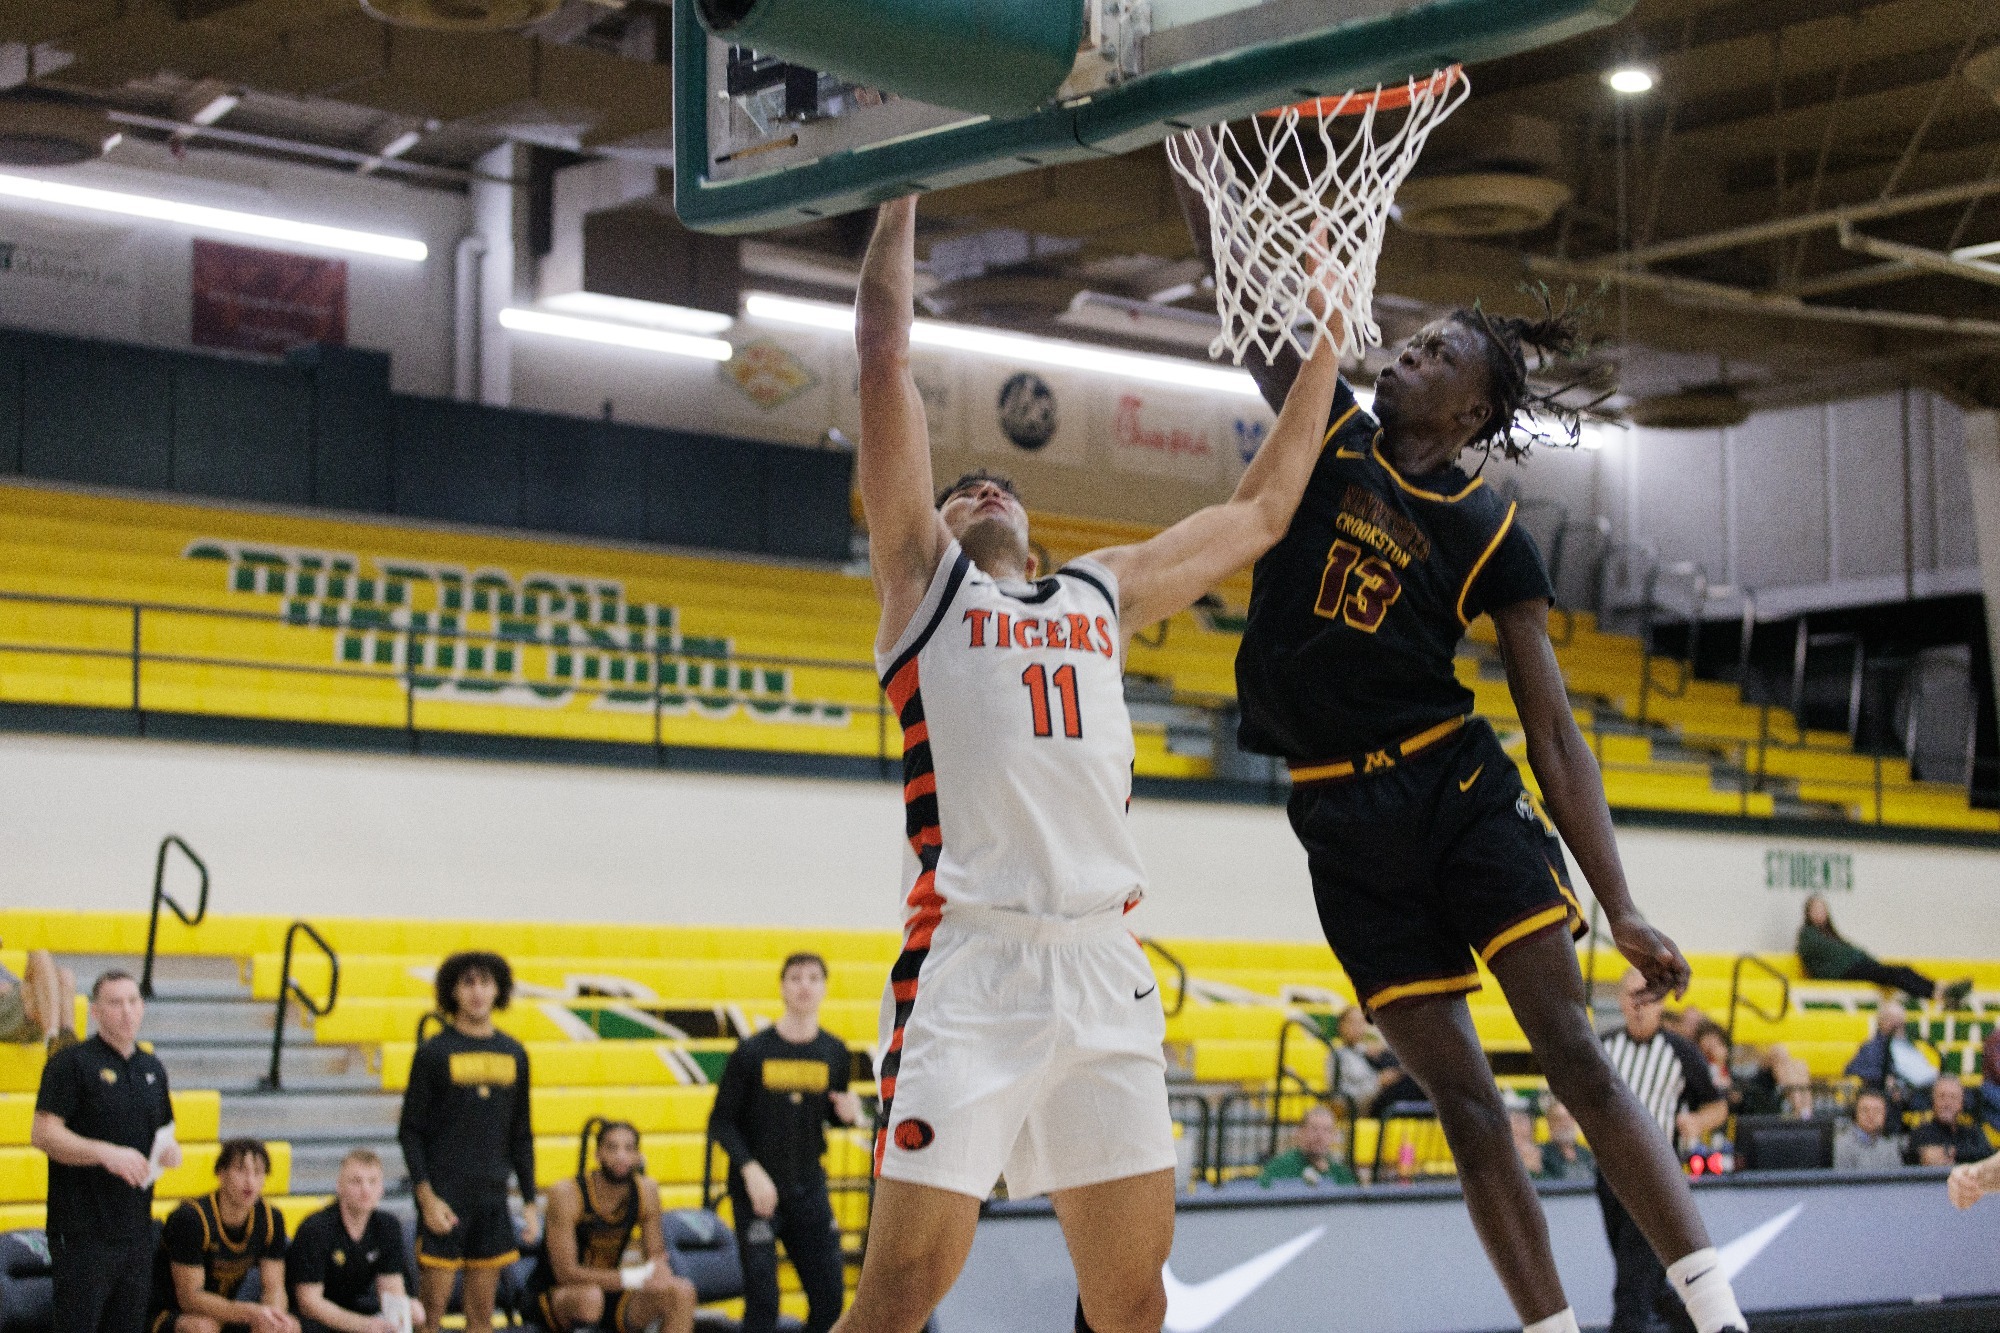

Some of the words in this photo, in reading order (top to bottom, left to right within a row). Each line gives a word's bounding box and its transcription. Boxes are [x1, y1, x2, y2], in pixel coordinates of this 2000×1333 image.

[1335, 511, 1412, 570] CROOKSTON
[1314, 538, 1401, 634] 13
[962, 608, 1114, 660] TIGERS
[1021, 663, 1083, 739] 11
[1364, 749, 1396, 773] M
[1766, 850, 1854, 891] STUDENTS
